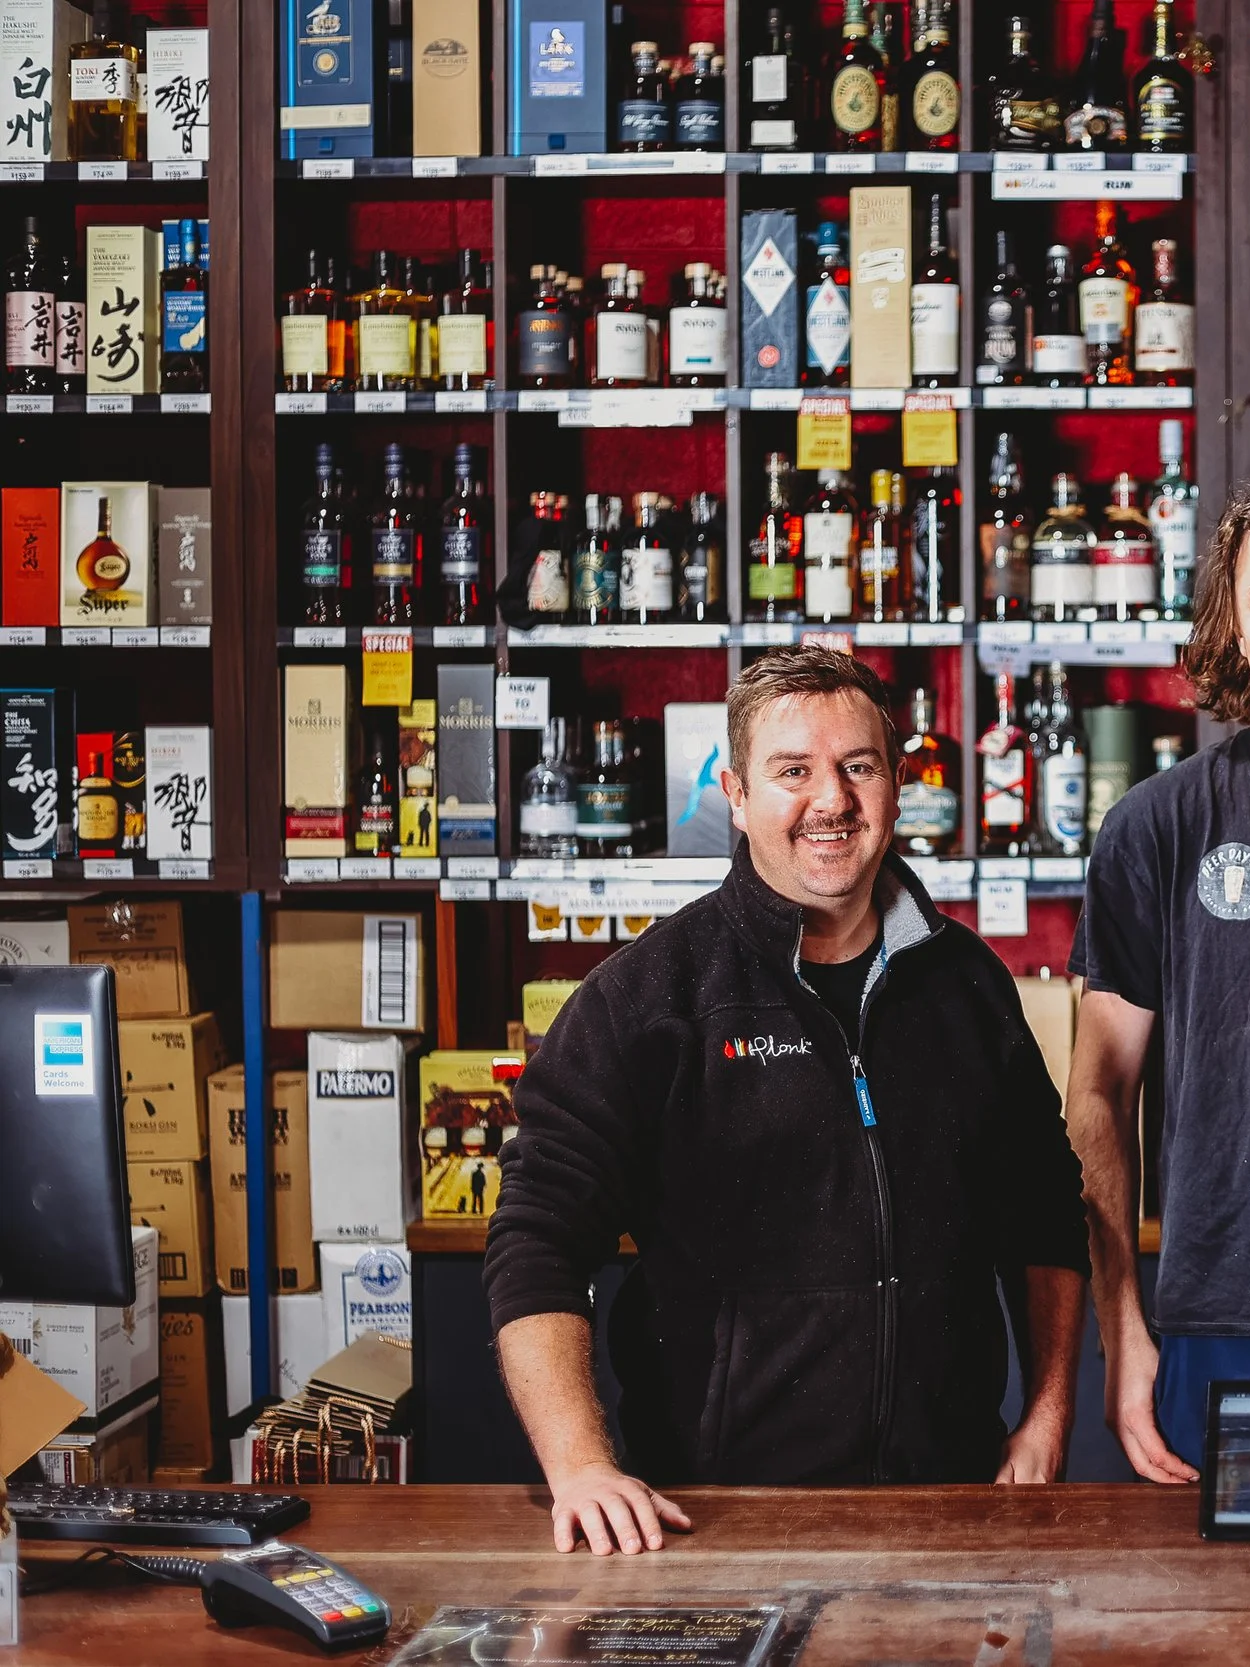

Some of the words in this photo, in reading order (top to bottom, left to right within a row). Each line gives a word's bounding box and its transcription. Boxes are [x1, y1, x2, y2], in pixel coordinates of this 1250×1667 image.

[102, 62, 120, 94] 季
[7, 57, 52, 155] 白州
[77, 588, 129, 615] Super
[366, 637, 409, 652] SPECIAL
[289, 717, 341, 727] MORRIS
[439, 716, 492, 727] MORRIS
[154, 773, 211, 852] 響
[1228, 848, 1250, 863] DAY
[752, 1035, 812, 1066] Plonk
[319, 1073, 391, 1097] PALERMO
[350, 1303, 410, 1315] PEARSON
[563, 1614, 687, 1627] Champagne
